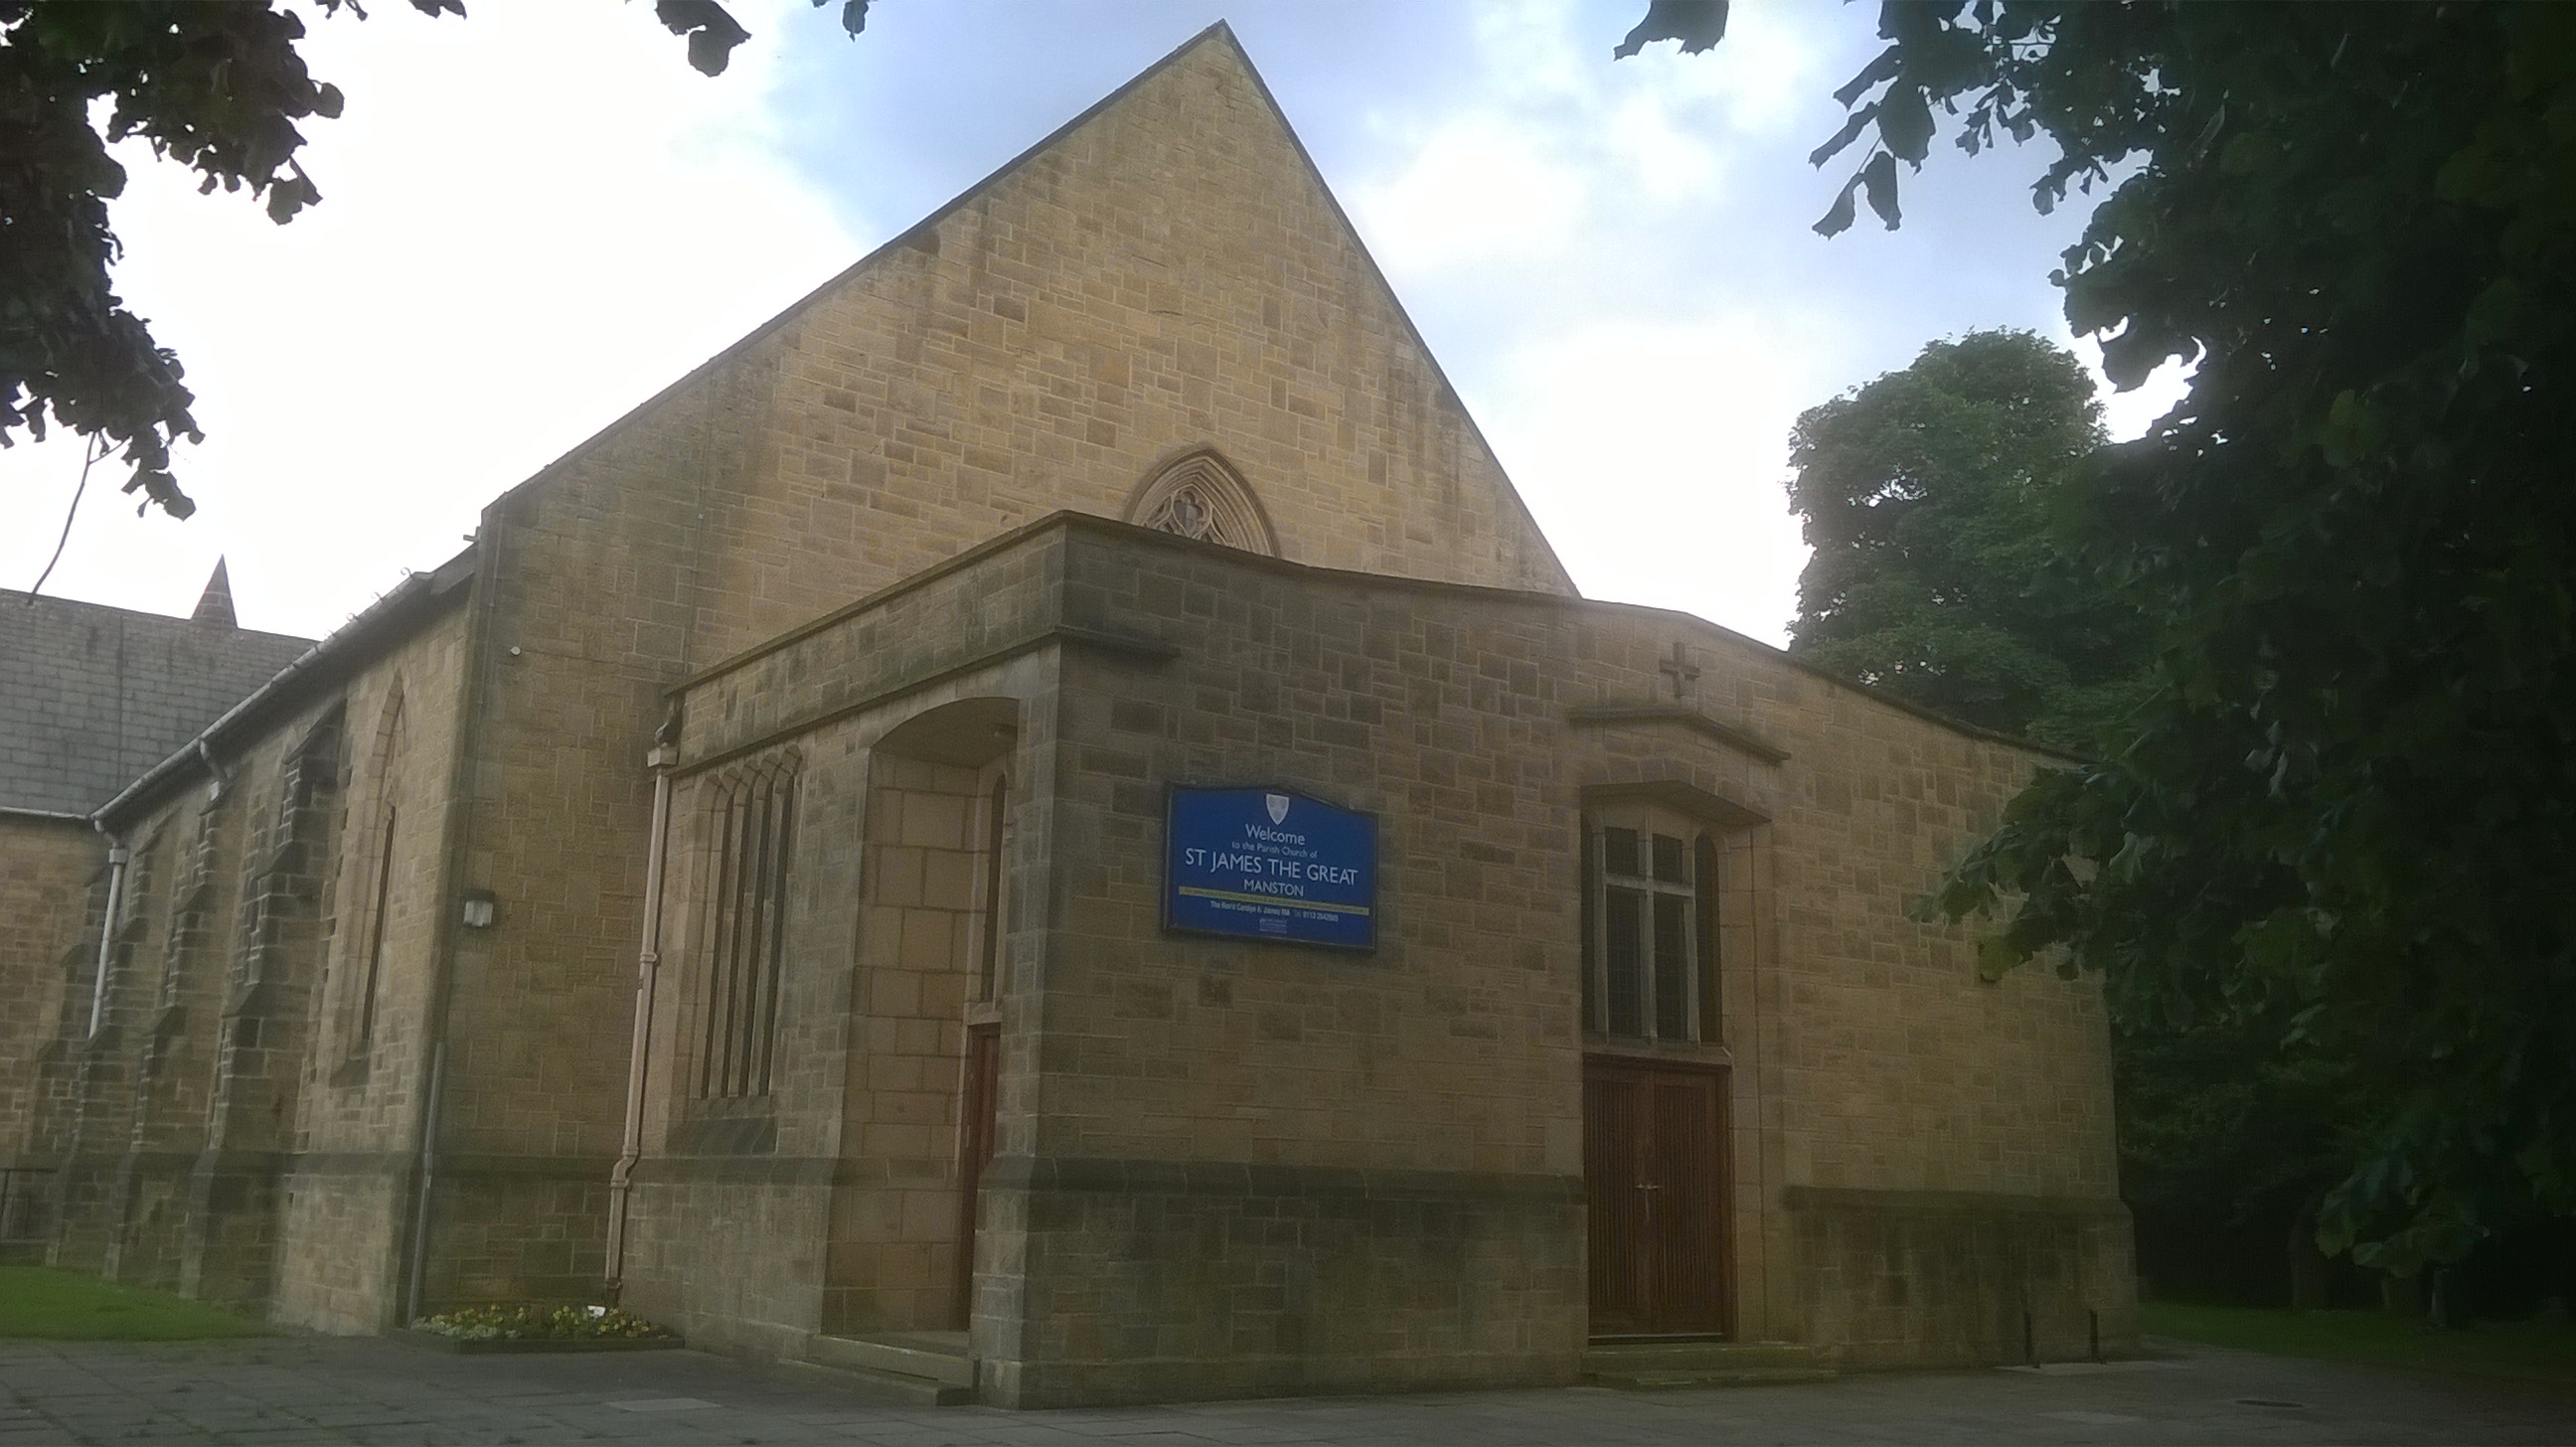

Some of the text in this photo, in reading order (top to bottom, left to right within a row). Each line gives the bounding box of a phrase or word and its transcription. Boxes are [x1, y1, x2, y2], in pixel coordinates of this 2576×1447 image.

[1245, 824, 1306, 846] Welcome
[1231, 841, 1318, 859] to the Parish Church of
[1185, 848, 1359, 885] ST JAMES THE GREAT
[1243, 879, 1304, 897] MANSTON
[1209, 899, 1220, 908] The
